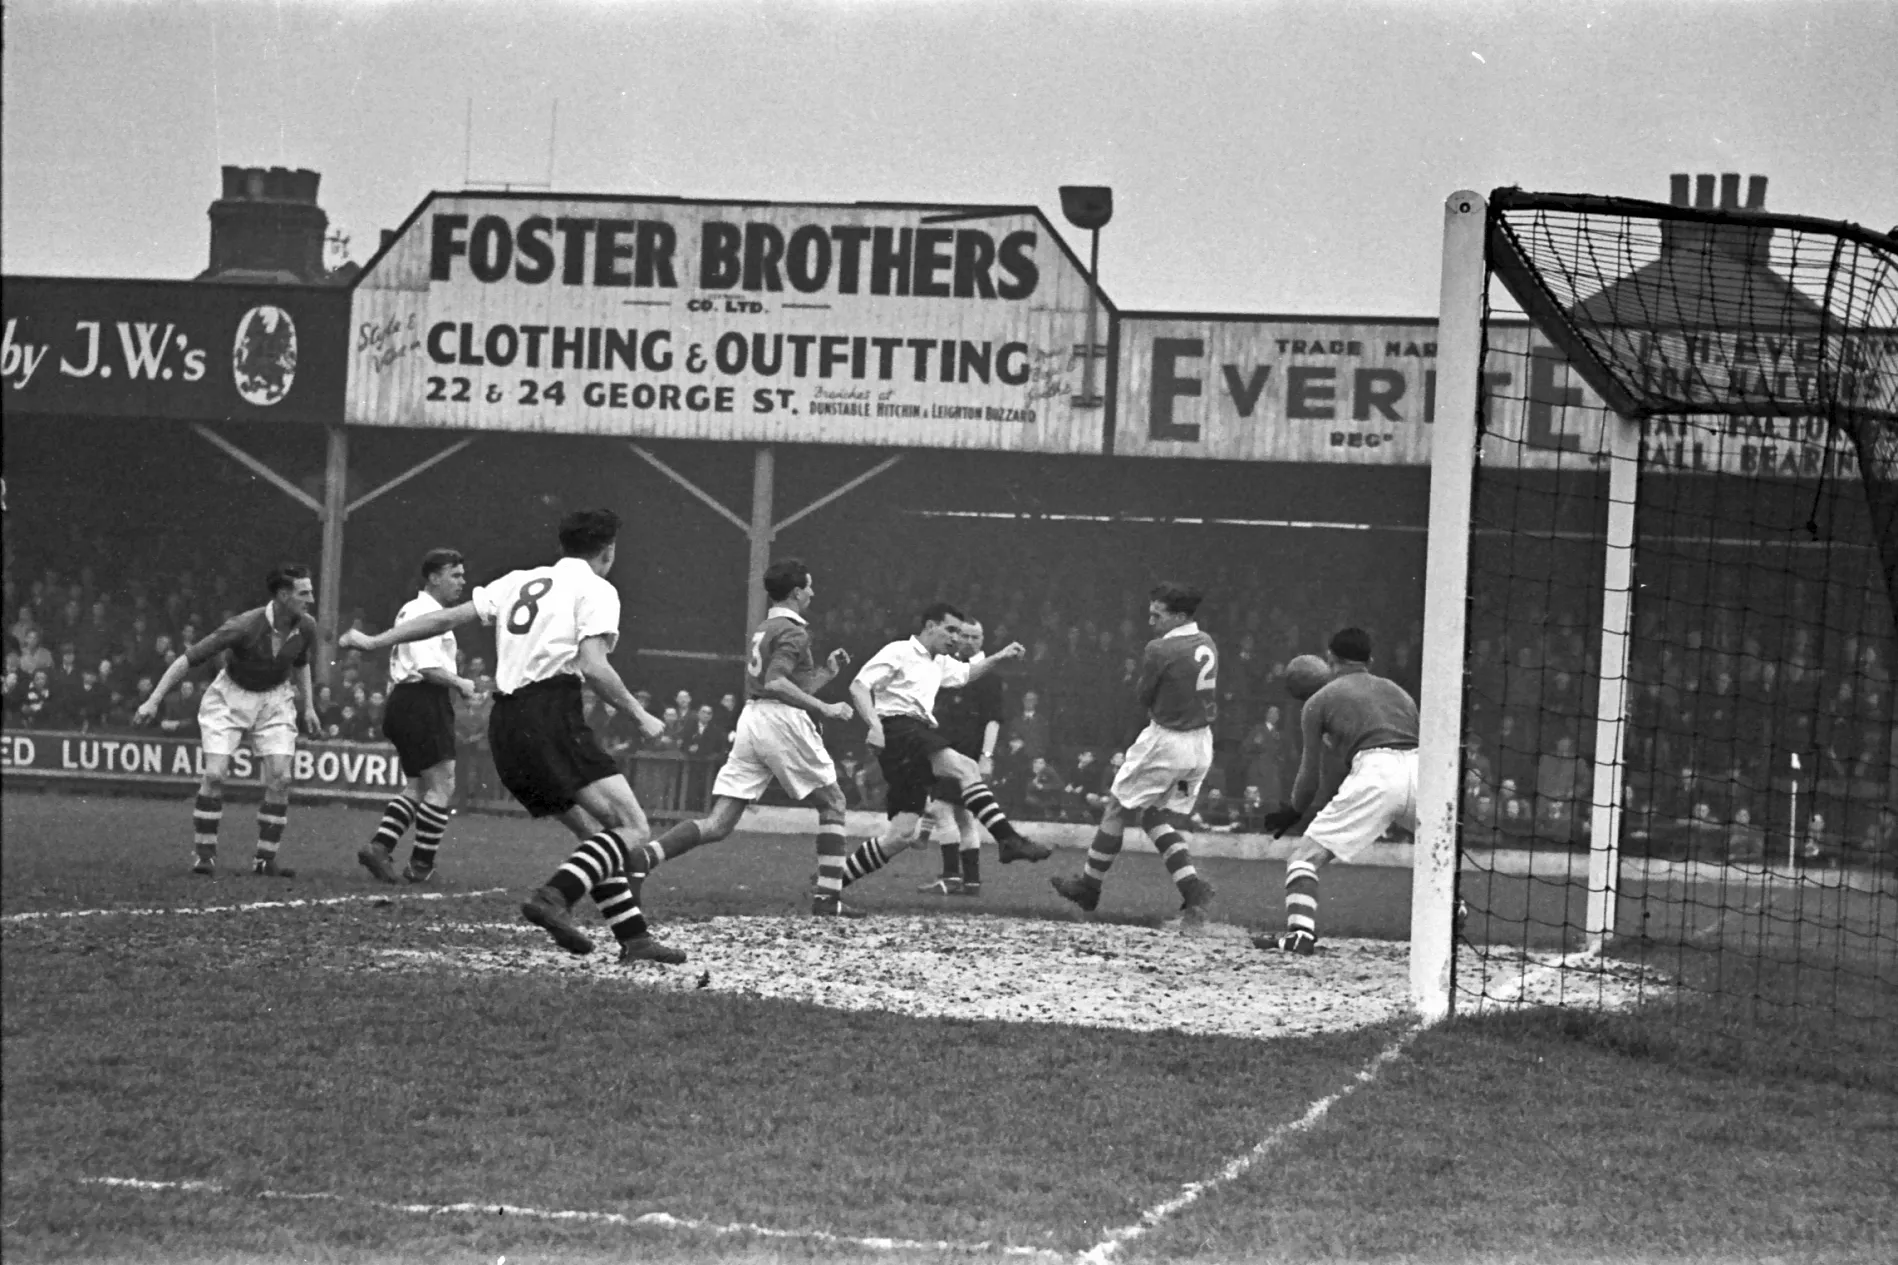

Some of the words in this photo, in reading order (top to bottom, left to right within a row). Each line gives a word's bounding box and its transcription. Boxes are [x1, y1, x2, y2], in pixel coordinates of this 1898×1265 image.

[430, 213, 678, 288] FOSTER
[700, 221, 1039, 300] BROTHERS
[0, 318, 49, 390] by
[427, 321, 673, 372] CLOTHING
[685, 343, 707, 373] &
[715, 331, 1030, 386] OUTFITTING
[1275, 339, 1362, 356] TRADE
[1385, 341, 1438, 357] MAR
[426, 376, 471, 402] 22
[485, 384, 503, 403] &
[518, 380, 565, 406] 24
[583, 382, 734, 412] GEORGE
[753, 388, 799, 416] ST.
[809, 400, 870, 417] DUNSTABLE
[877, 403, 920, 419] HITCHIN
[931, 403, 982, 420] LEIGHTON
[985, 406, 1036, 424] BUZZARD
[507, 577, 553, 635] 8
[1194, 645, 1216, 691] 2
[62, 739, 162, 773] LUTON
[172, 745, 253, 777] ALS
